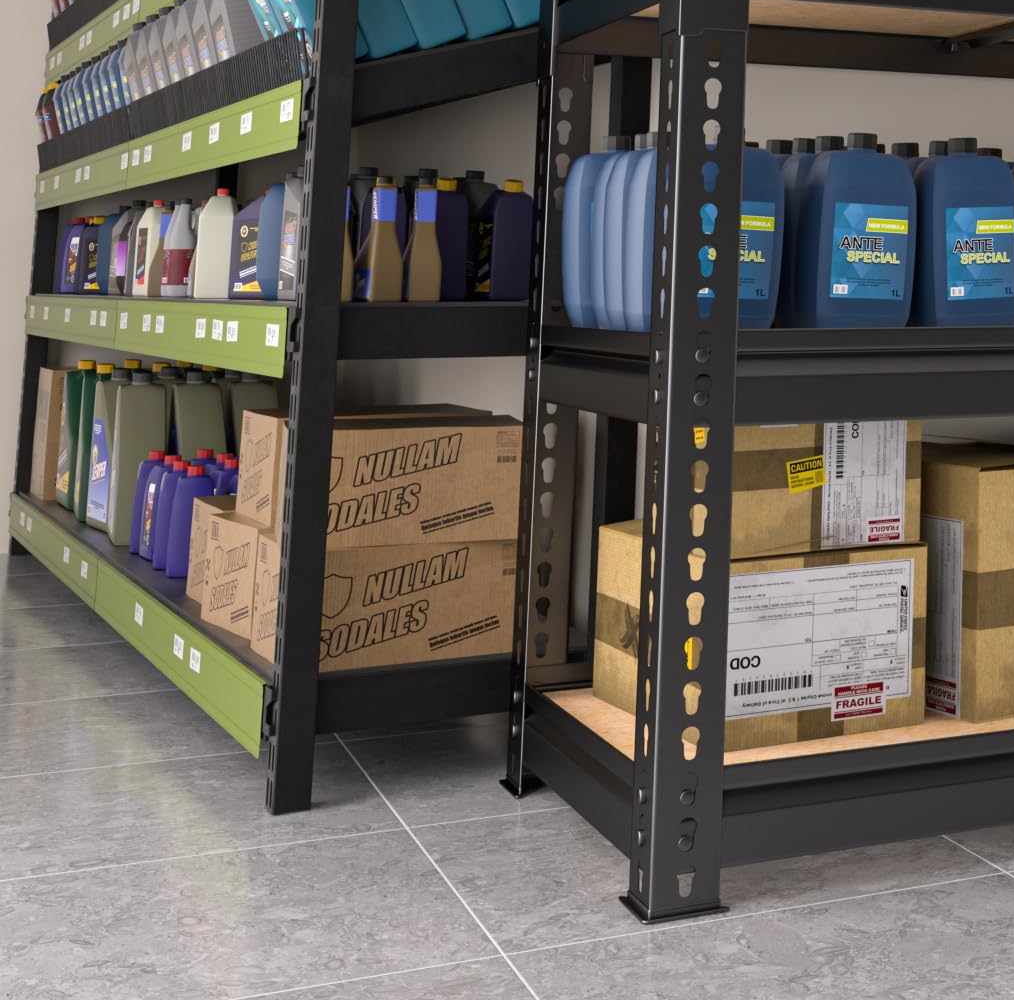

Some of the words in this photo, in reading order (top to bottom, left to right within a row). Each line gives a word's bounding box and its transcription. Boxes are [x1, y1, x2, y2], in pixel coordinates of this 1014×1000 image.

[839, 235, 884, 251] ANTE
[953, 238, 994, 254] ANTE
[738, 250, 766, 262] CIAL
[846, 250, 901, 264] SPECIAL
[960, 252, 1010, 265] SPECIAL
[851, 422, 860, 439] CO
[353, 433, 462, 487] NULLAM
[791, 459, 822, 473] CAUTION
[326, 483, 421, 536] ODALES
[869, 523, 900, 534] FRAGILE
[362, 547, 469, 607] NULLAM
[730, 655, 761, 670] COD
[836, 696, 882, 709] FRAGILE
